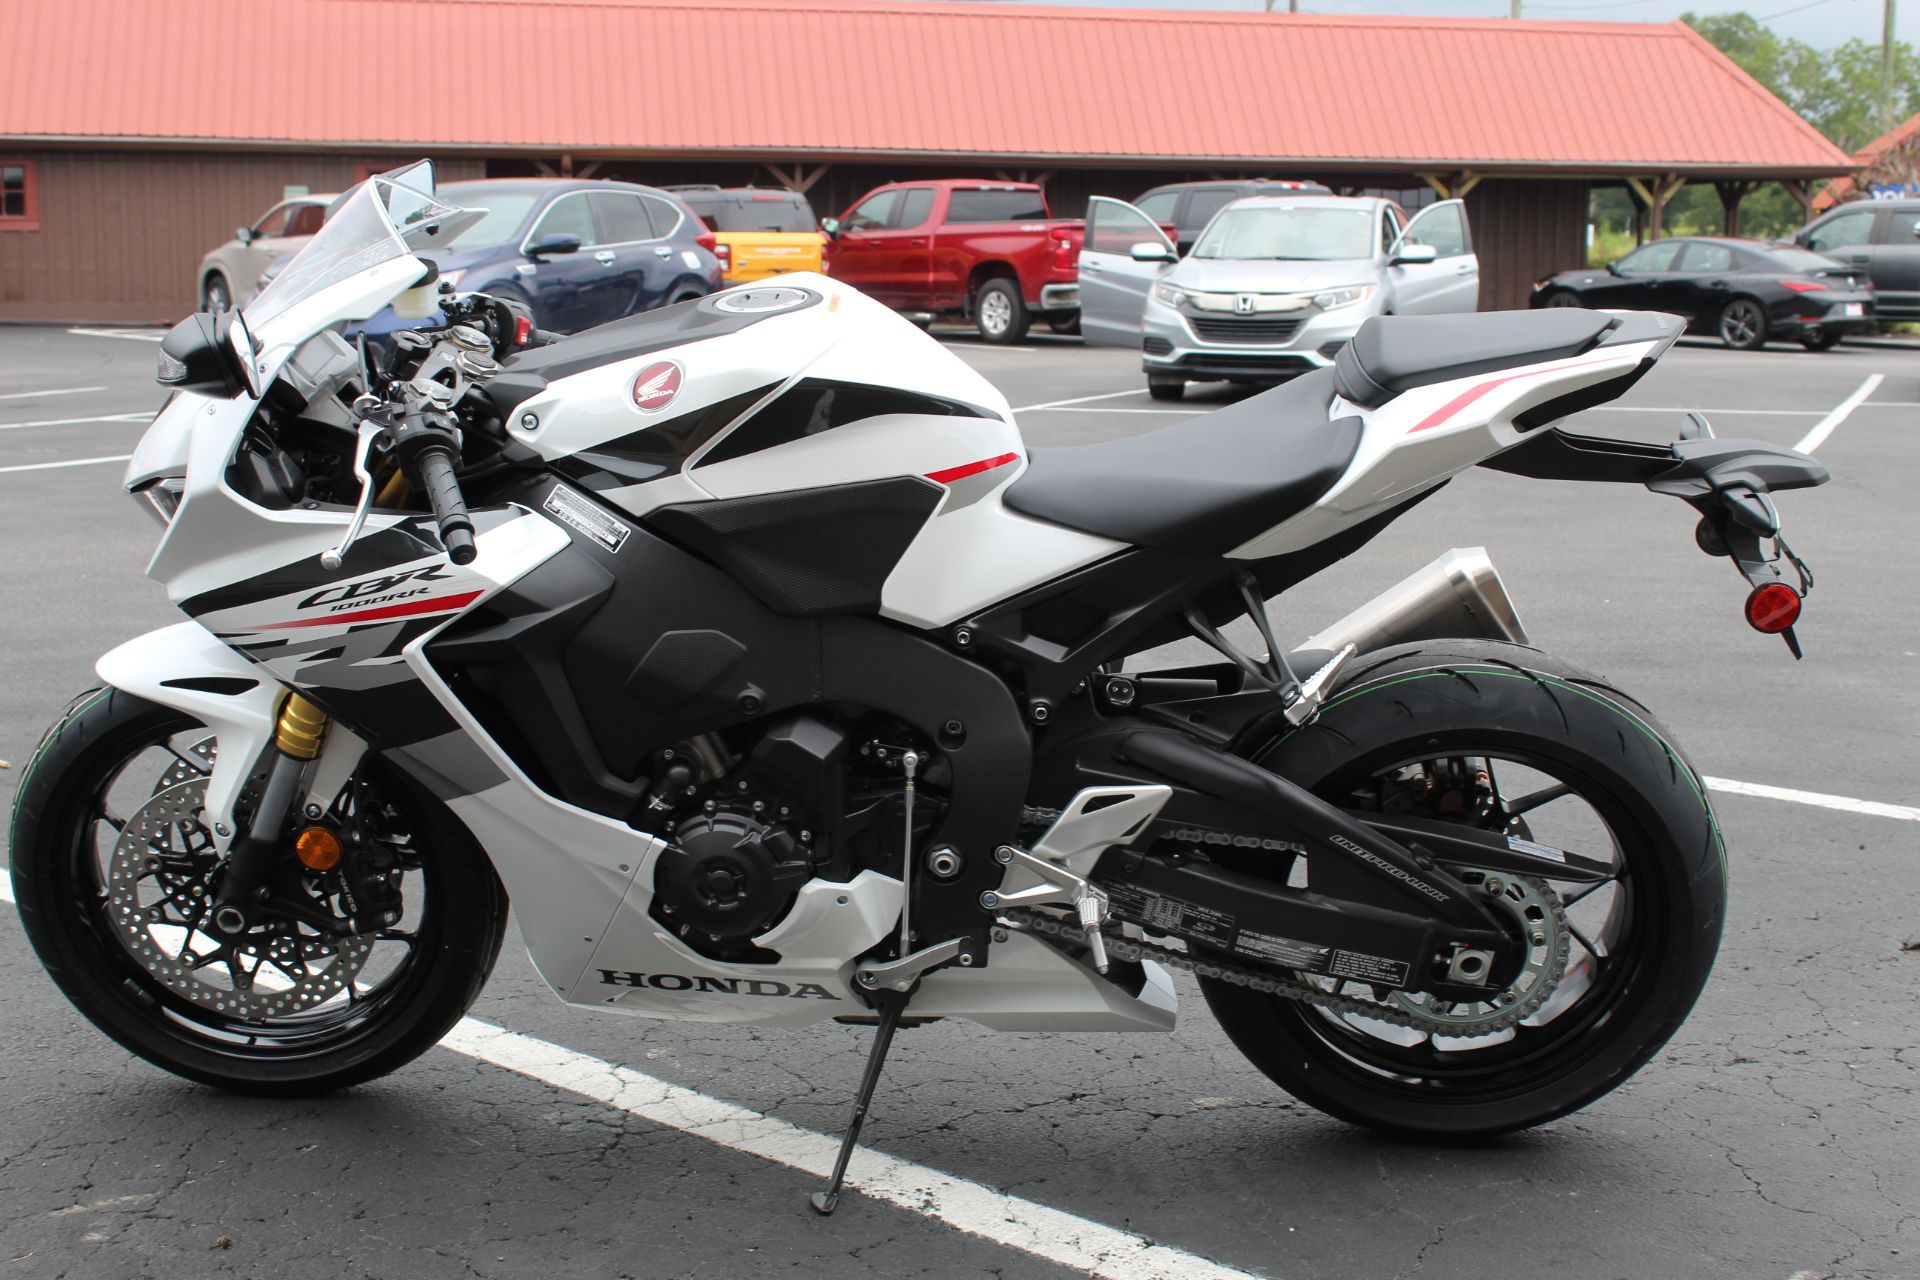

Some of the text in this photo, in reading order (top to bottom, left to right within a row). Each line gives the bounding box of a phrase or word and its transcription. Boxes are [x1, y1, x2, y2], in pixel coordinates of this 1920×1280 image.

[637, 389, 675, 402] HONDA
[297, 563, 455, 609] CBR
[329, 587, 431, 611] 1000RR
[337, 869, 357, 912] TOKICO
[596, 968, 842, 1000] HONDA
